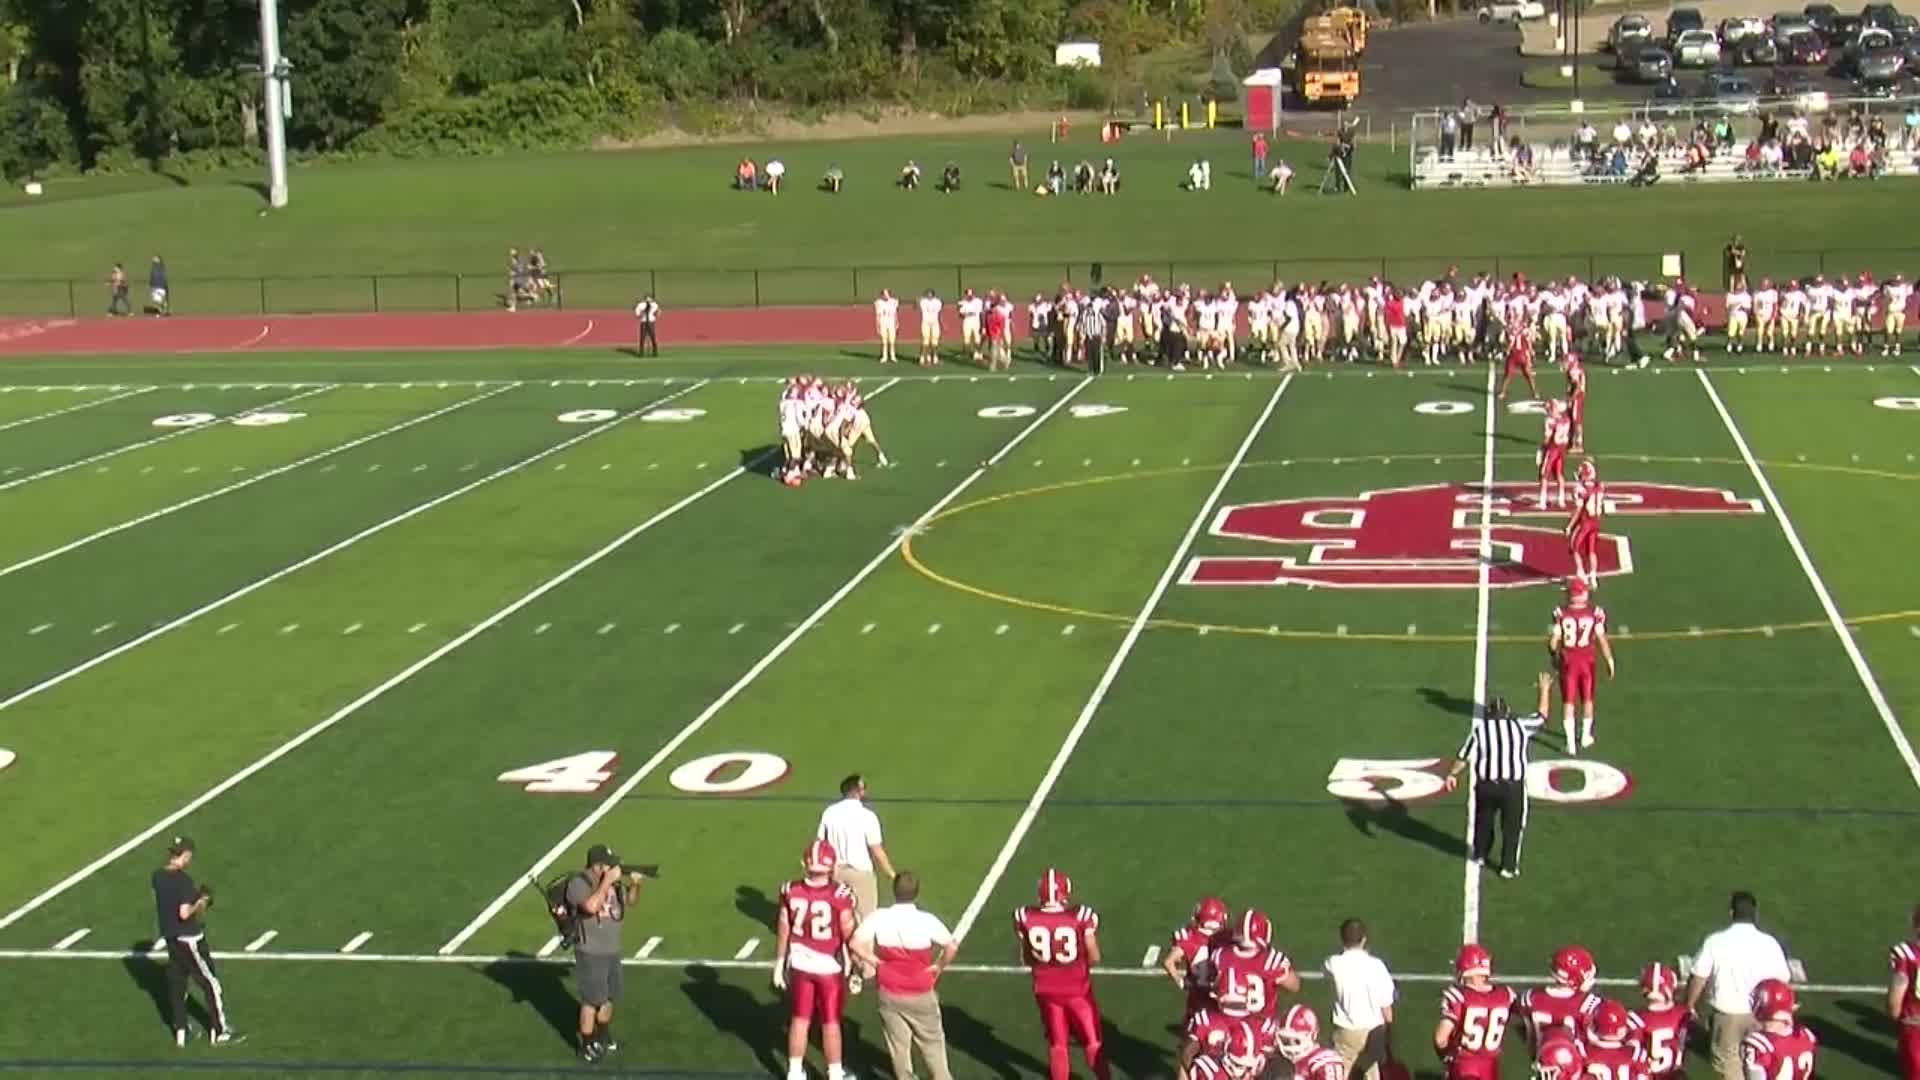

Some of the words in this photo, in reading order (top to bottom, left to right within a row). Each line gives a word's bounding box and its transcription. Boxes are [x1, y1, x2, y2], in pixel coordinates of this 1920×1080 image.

[1560, 617, 1595, 648] 87
[788, 897, 833, 941] 72
[1027, 925, 1078, 964] 93
[1461, 1007, 1510, 1051] 56
